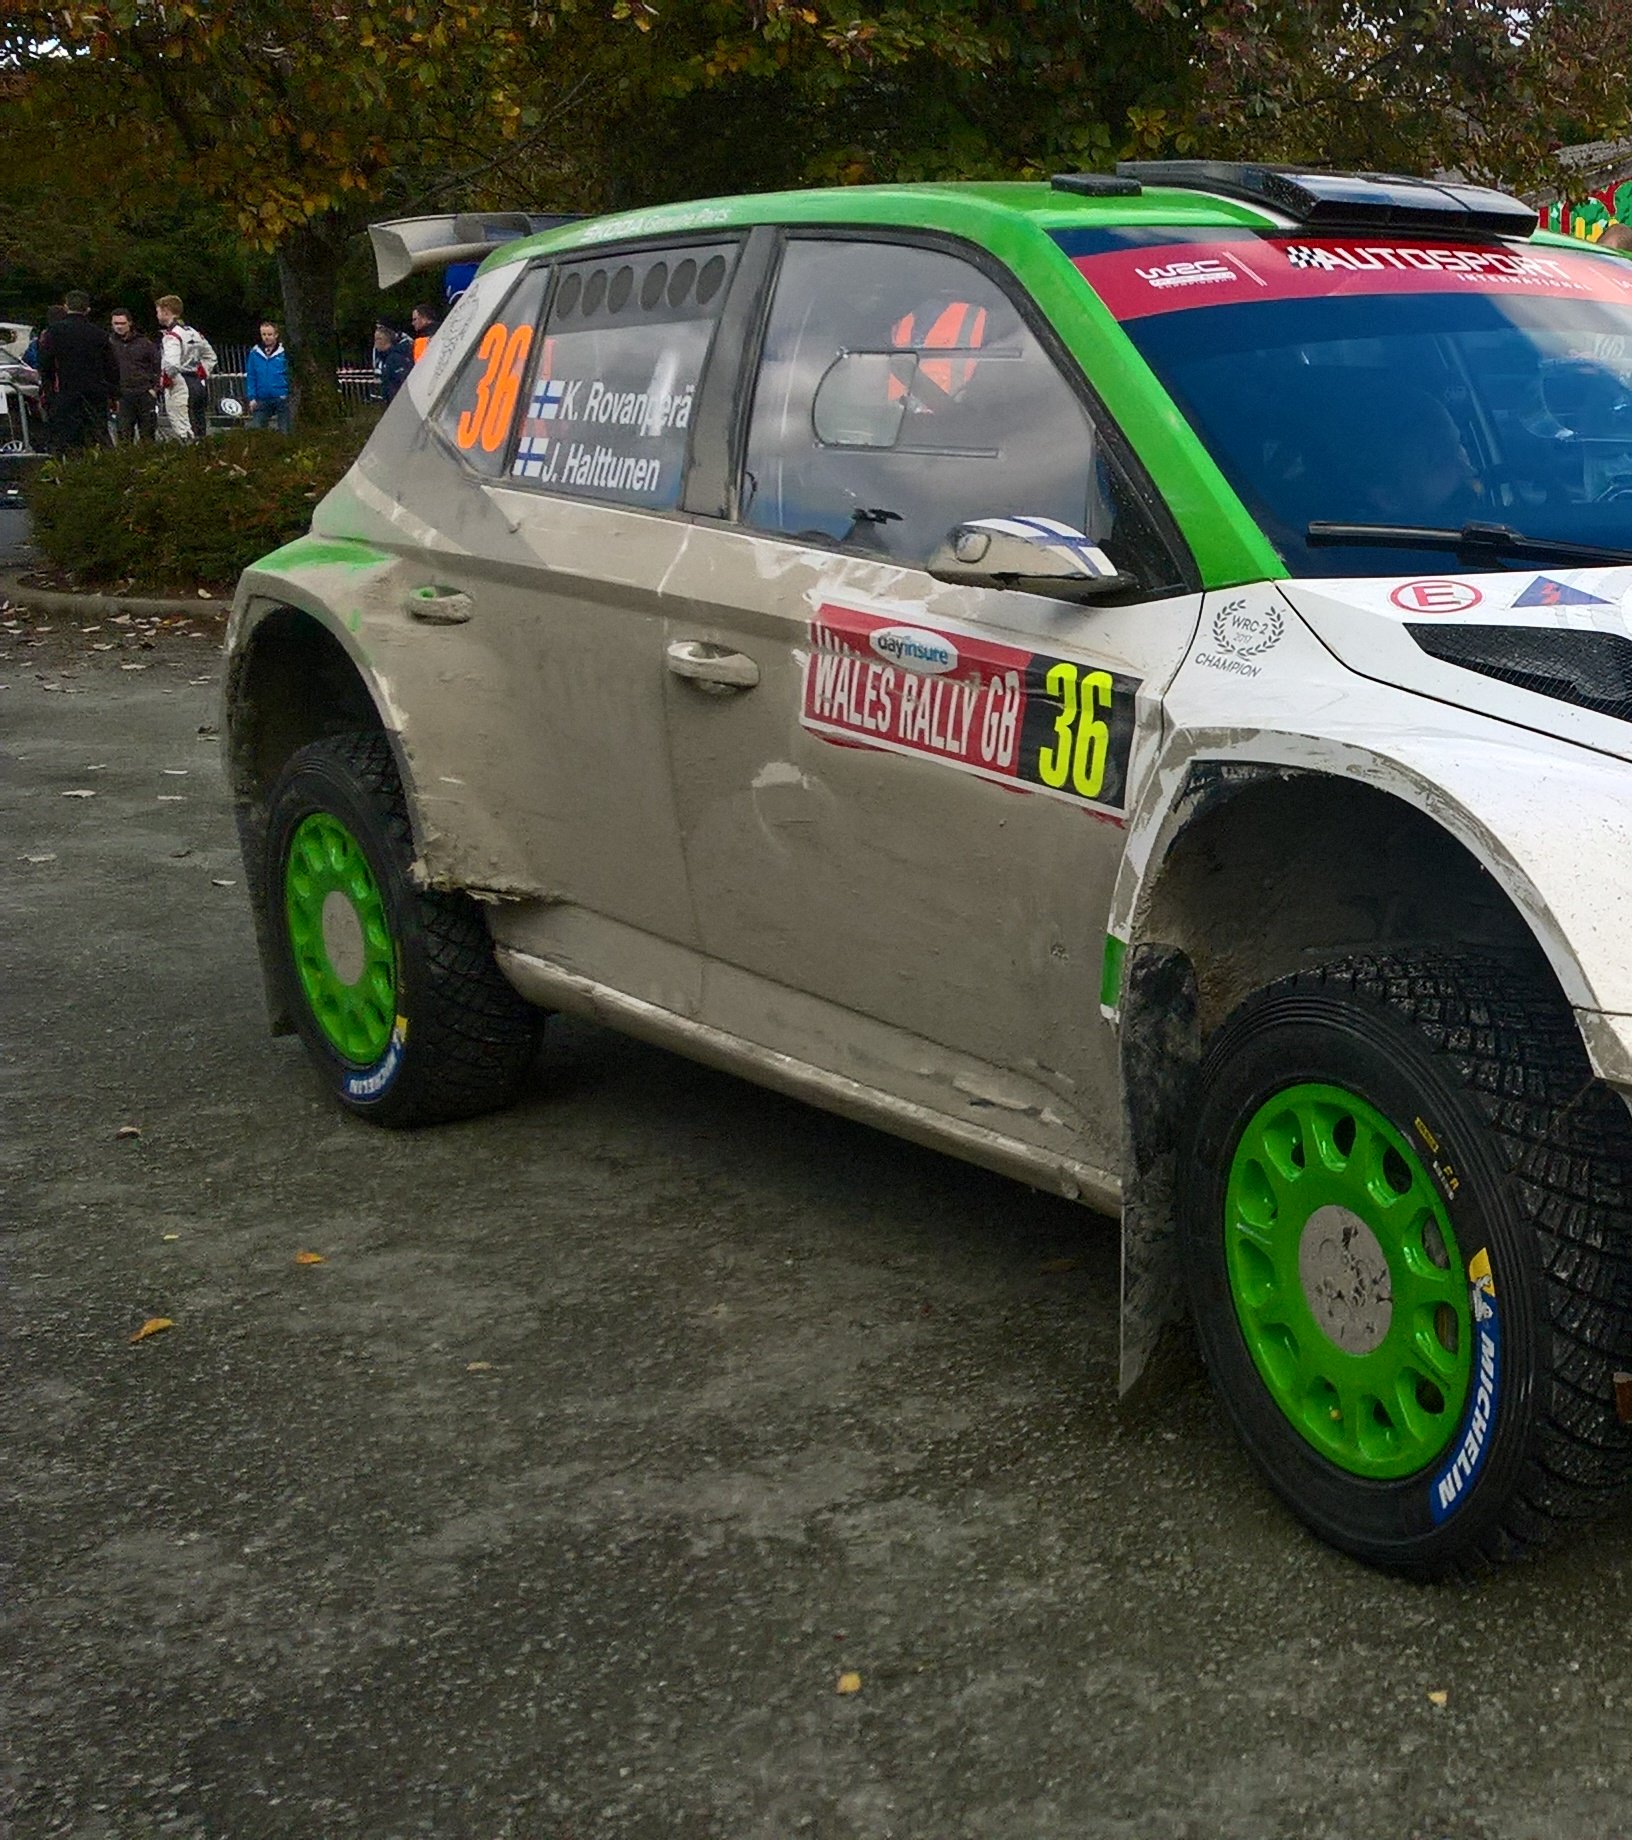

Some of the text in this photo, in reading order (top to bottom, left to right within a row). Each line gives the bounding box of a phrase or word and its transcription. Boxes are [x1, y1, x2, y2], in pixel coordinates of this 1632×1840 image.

[1134, 259, 1229, 280] WRC
[1312, 247, 1571, 280] AUTOSPORT
[1456, 273, 1594, 292] INTERNATIONAL
[457, 323, 534, 453] 36
[559, 380, 697, 437] K. Rovanperä
[541, 441, 662, 493] J. Halttunen
[1231, 614, 1269, 636] WRC 2
[877, 632, 949, 666] dayinsure
[1194, 652, 1263, 678] CHAMPION
[813, 624, 1021, 768] WALES RALLY GB
[1038, 662, 1114, 799] 36
[1437, 1330, 1497, 1510] MICHELIN
